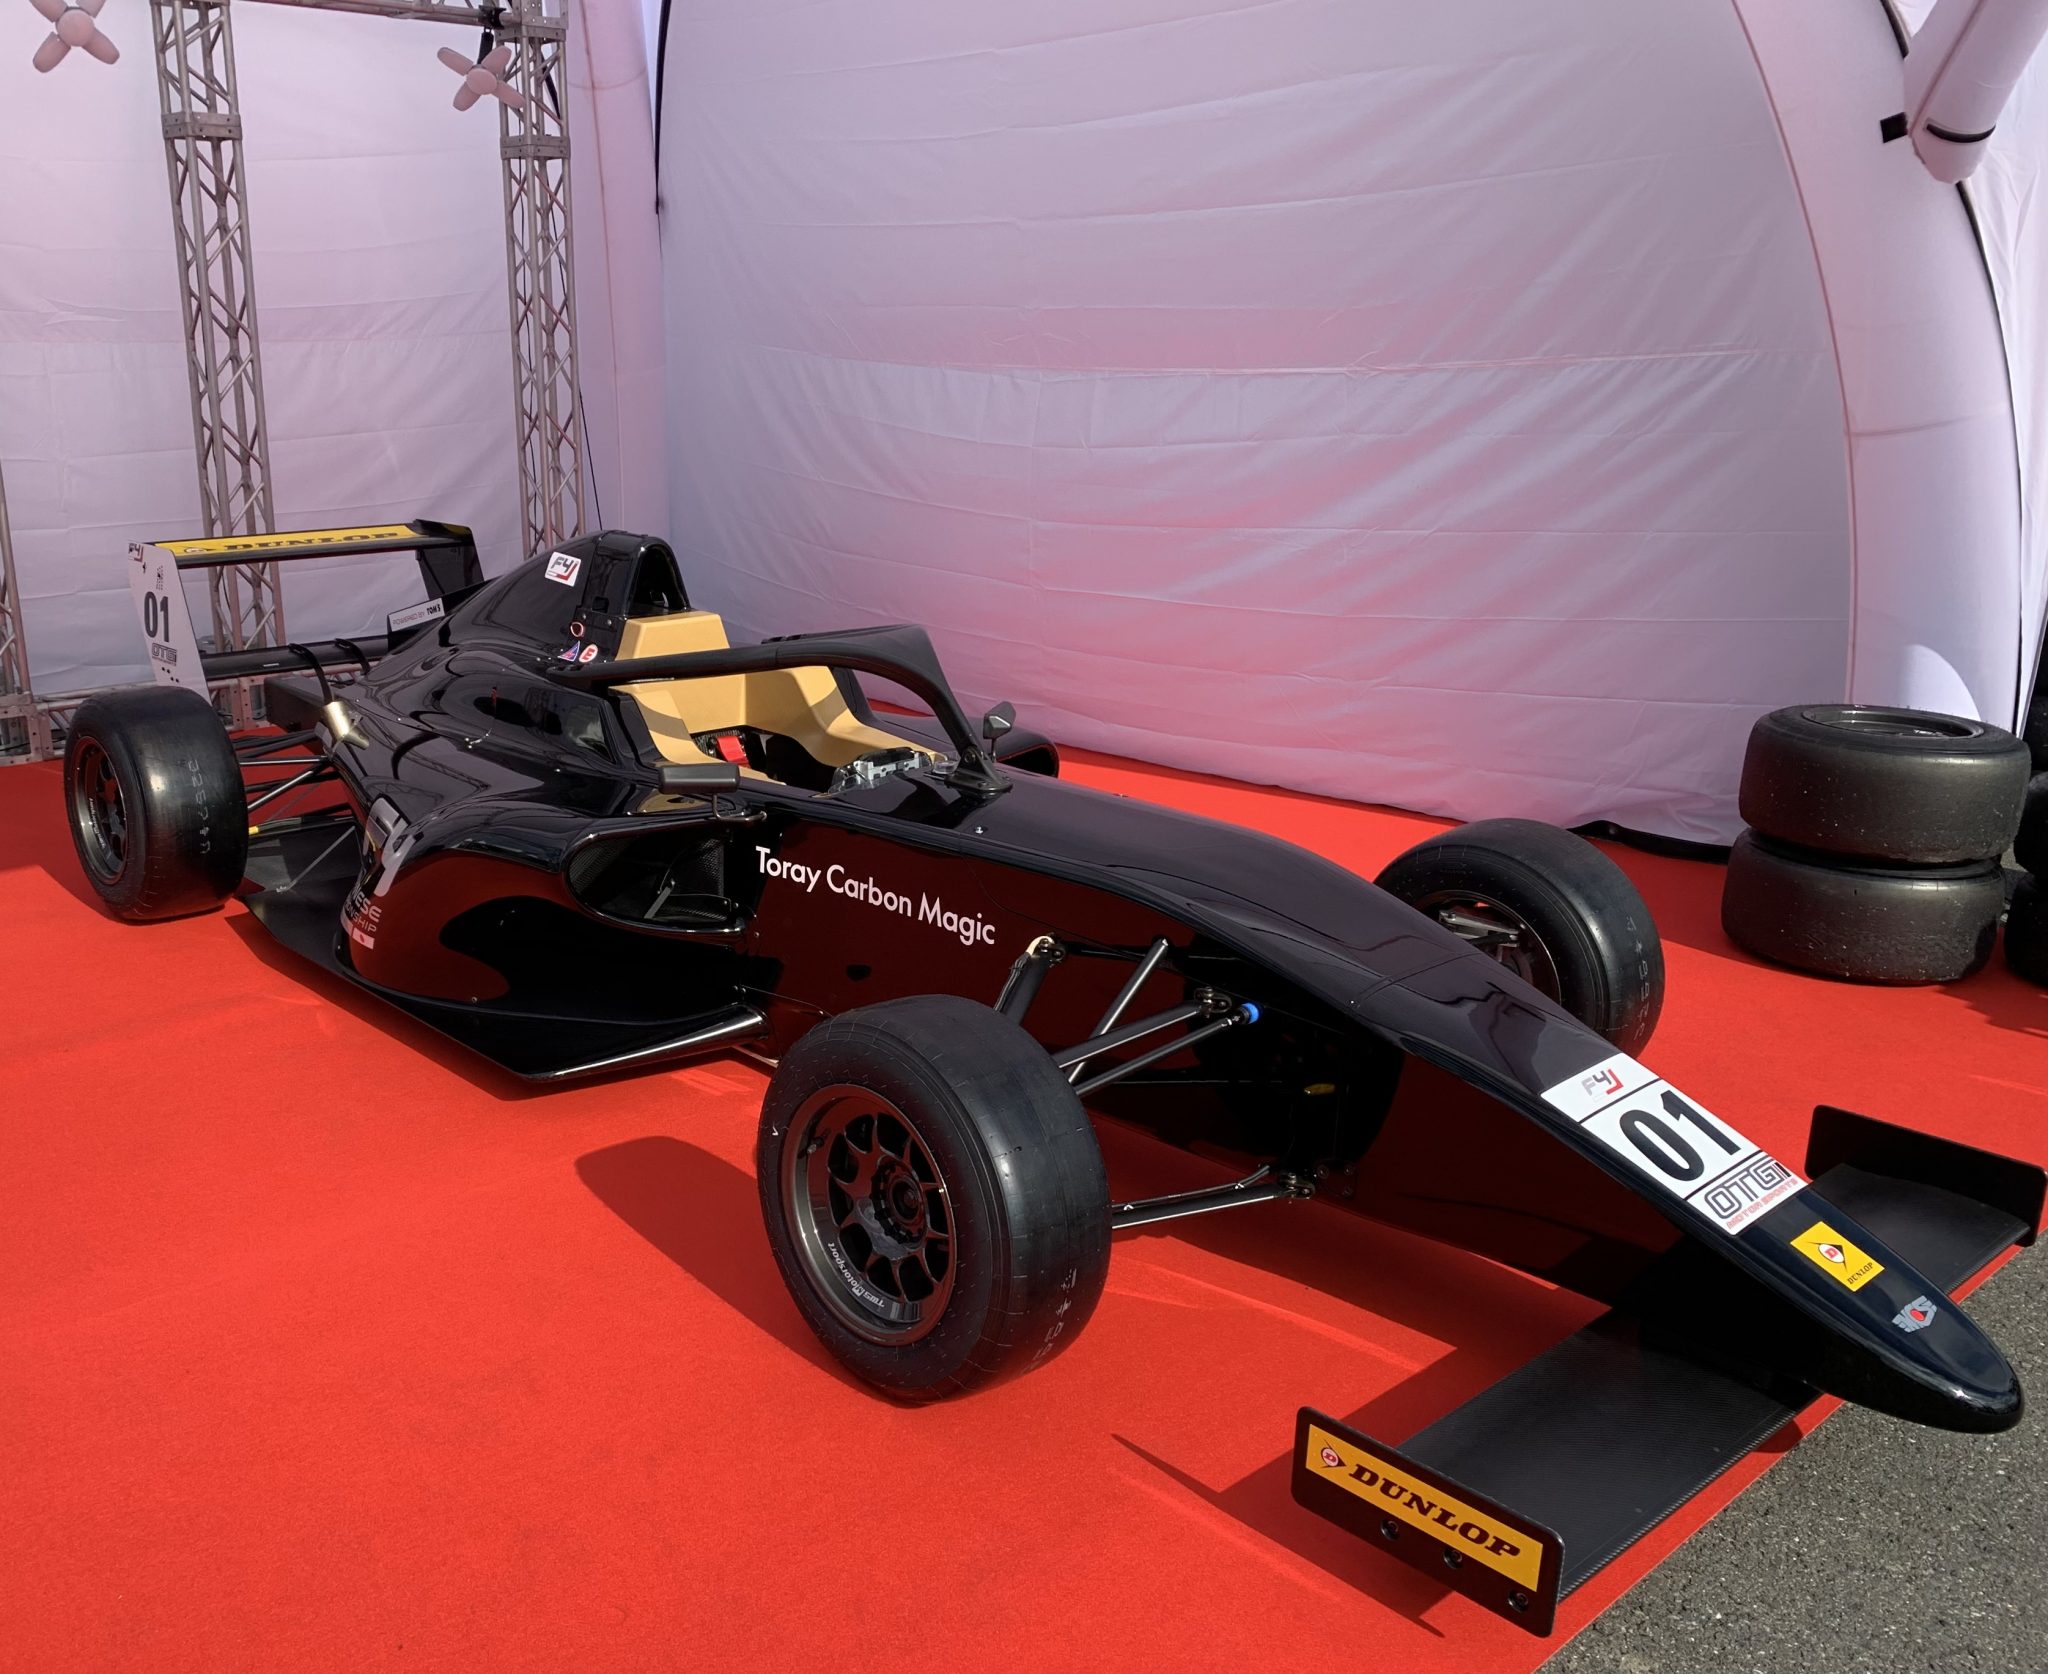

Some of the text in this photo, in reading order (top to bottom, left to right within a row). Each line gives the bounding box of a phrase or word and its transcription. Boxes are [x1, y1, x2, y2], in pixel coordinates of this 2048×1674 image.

[225, 532, 398, 550] DUNLOP
[144, 591, 169, 643] 01
[755, 845, 996, 946] Toray Carbon Magic
[1619, 1090, 1741, 1182] 01
[1847, 1262, 1874, 1285] DUNLOP
[1348, 1464, 1521, 1557] DUNLOP
